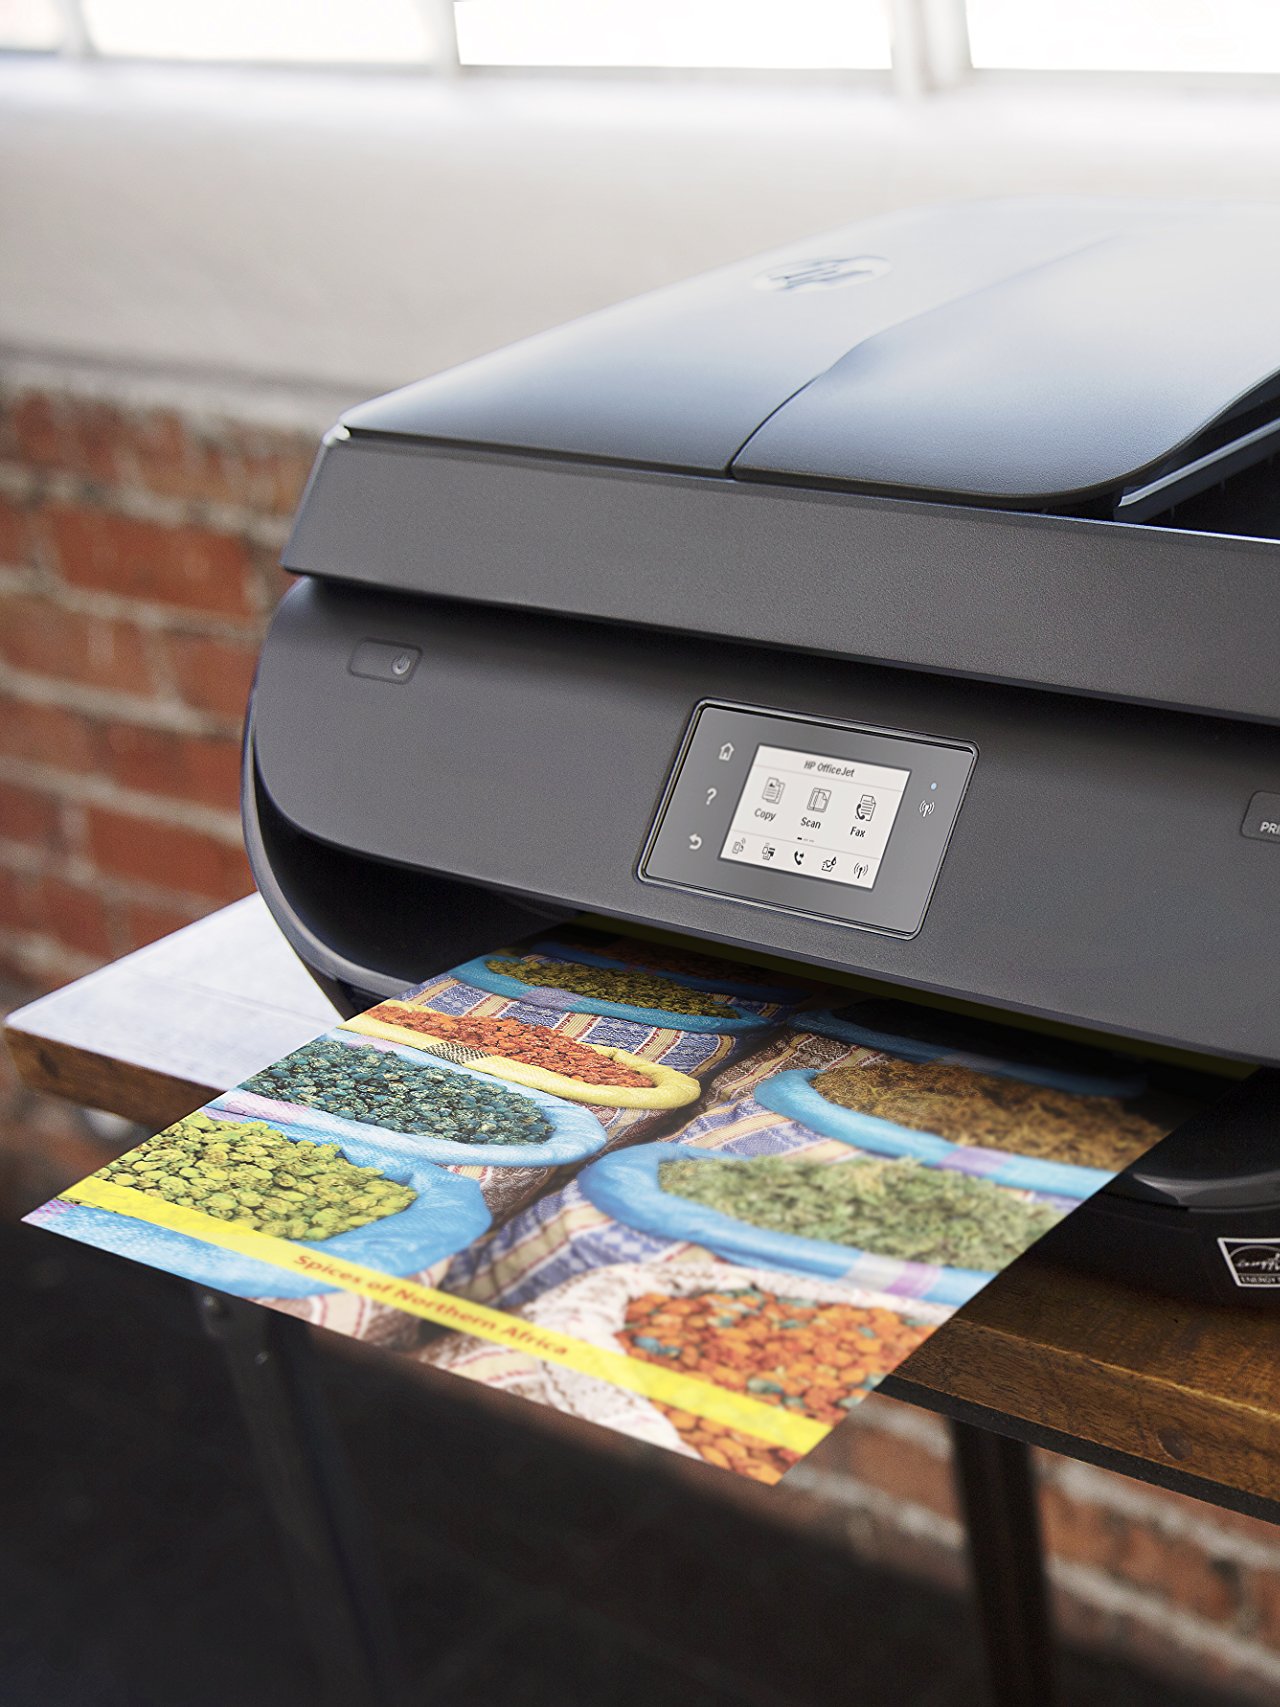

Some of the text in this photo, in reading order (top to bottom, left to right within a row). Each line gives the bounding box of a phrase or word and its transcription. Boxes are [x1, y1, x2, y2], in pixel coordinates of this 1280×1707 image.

[803, 760, 856, 778] HP OfficeJet
[754, 808, 776, 822] Copy
[800, 817, 821, 830] Scan
[850, 826, 866, 838] Fax
[294, 1254, 569, 1356] Spices of Northern Africa
